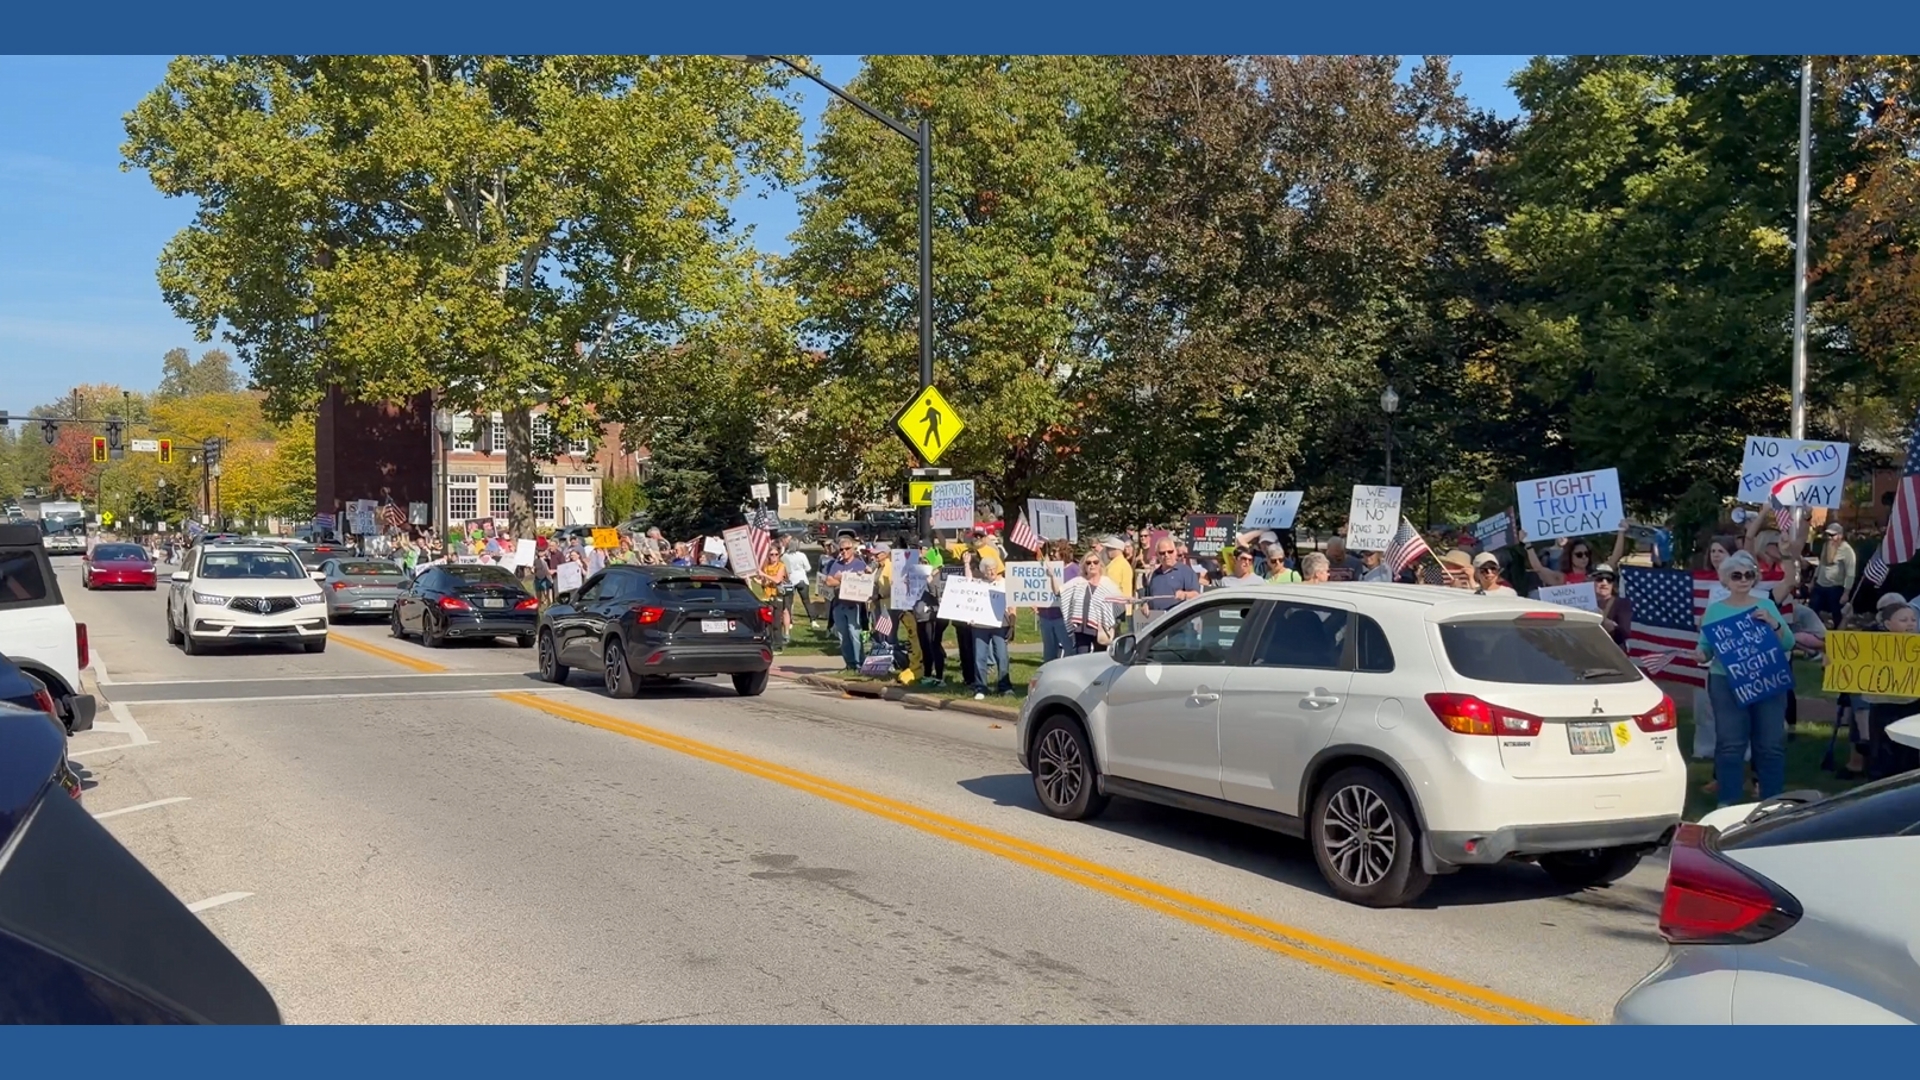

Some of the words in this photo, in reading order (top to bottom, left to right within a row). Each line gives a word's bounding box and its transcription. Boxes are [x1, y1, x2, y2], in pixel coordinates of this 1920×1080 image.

[1751, 440, 1779, 457] NO
[935, 482, 972, 497] PATRIOTS
[1366, 486, 1387, 497] WE
[1535, 474, 1596, 499] FIGHT
[1793, 484, 1836, 505] WAY
[1034, 500, 1066, 513] UNITED
[1533, 492, 1608, 517] TRUTH
[1254, 517, 1275, 525] TRUMP
[1366, 508, 1385, 521] NO
[1377, 524, 1391, 534] IN
[1537, 510, 1603, 536] DECAY
[1205, 527, 1228, 537] KINGS
[1193, 542, 1225, 551] AMERICA
[1024, 579, 1047, 589] NOT
[1735, 613, 1755, 631] not
[1831, 633, 1860, 661] NO
[1727, 647, 1778, 680] RIGHT
[1749, 669, 1762, 680] or
[1825, 664, 1854, 691] NO
[1735, 669, 1792, 704] WRONG
